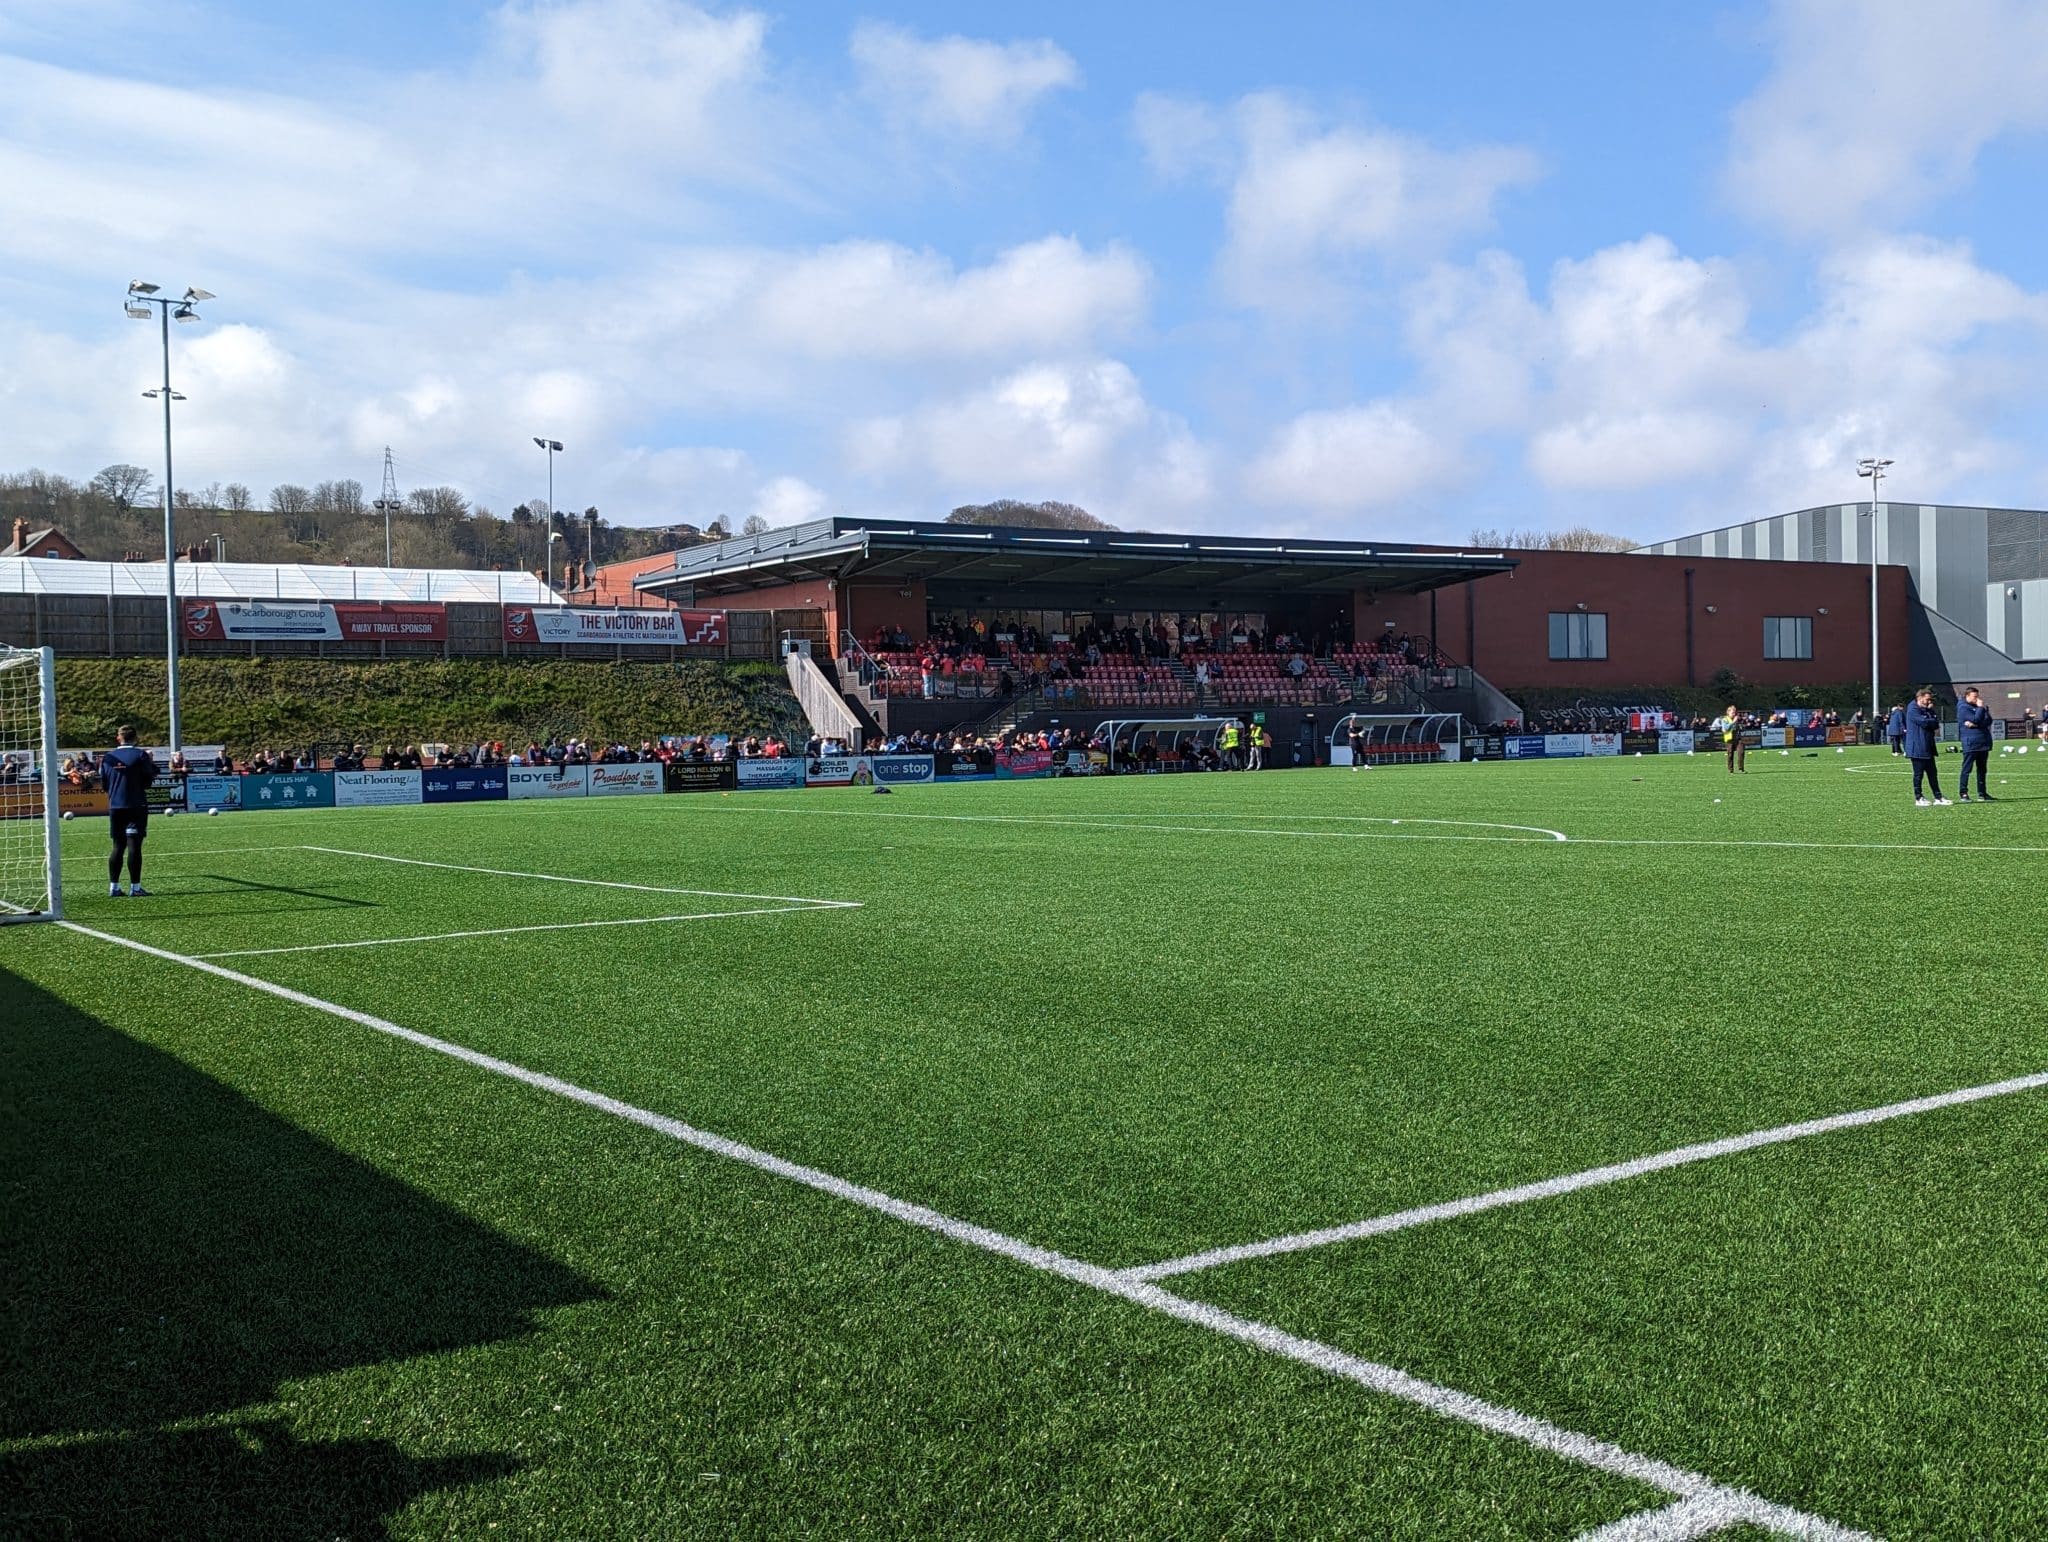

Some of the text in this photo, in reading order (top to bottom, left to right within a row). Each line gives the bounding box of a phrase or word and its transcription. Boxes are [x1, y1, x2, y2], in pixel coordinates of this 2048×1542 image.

[242, 609, 326, 620] Scarborough Group
[352, 624, 433, 634] AWAY TRAVEL SPONSOR
[580, 615, 675, 631] THE VICTORY BAR
[1540, 699, 1613, 720] everyone
[878, 762, 929, 776] one stop
[338, 776, 362, 785] Neat
[362, 774, 406, 786] Flooring
[510, 774, 563, 783] BOYES
[592, 768, 641, 787] Proudfoot
